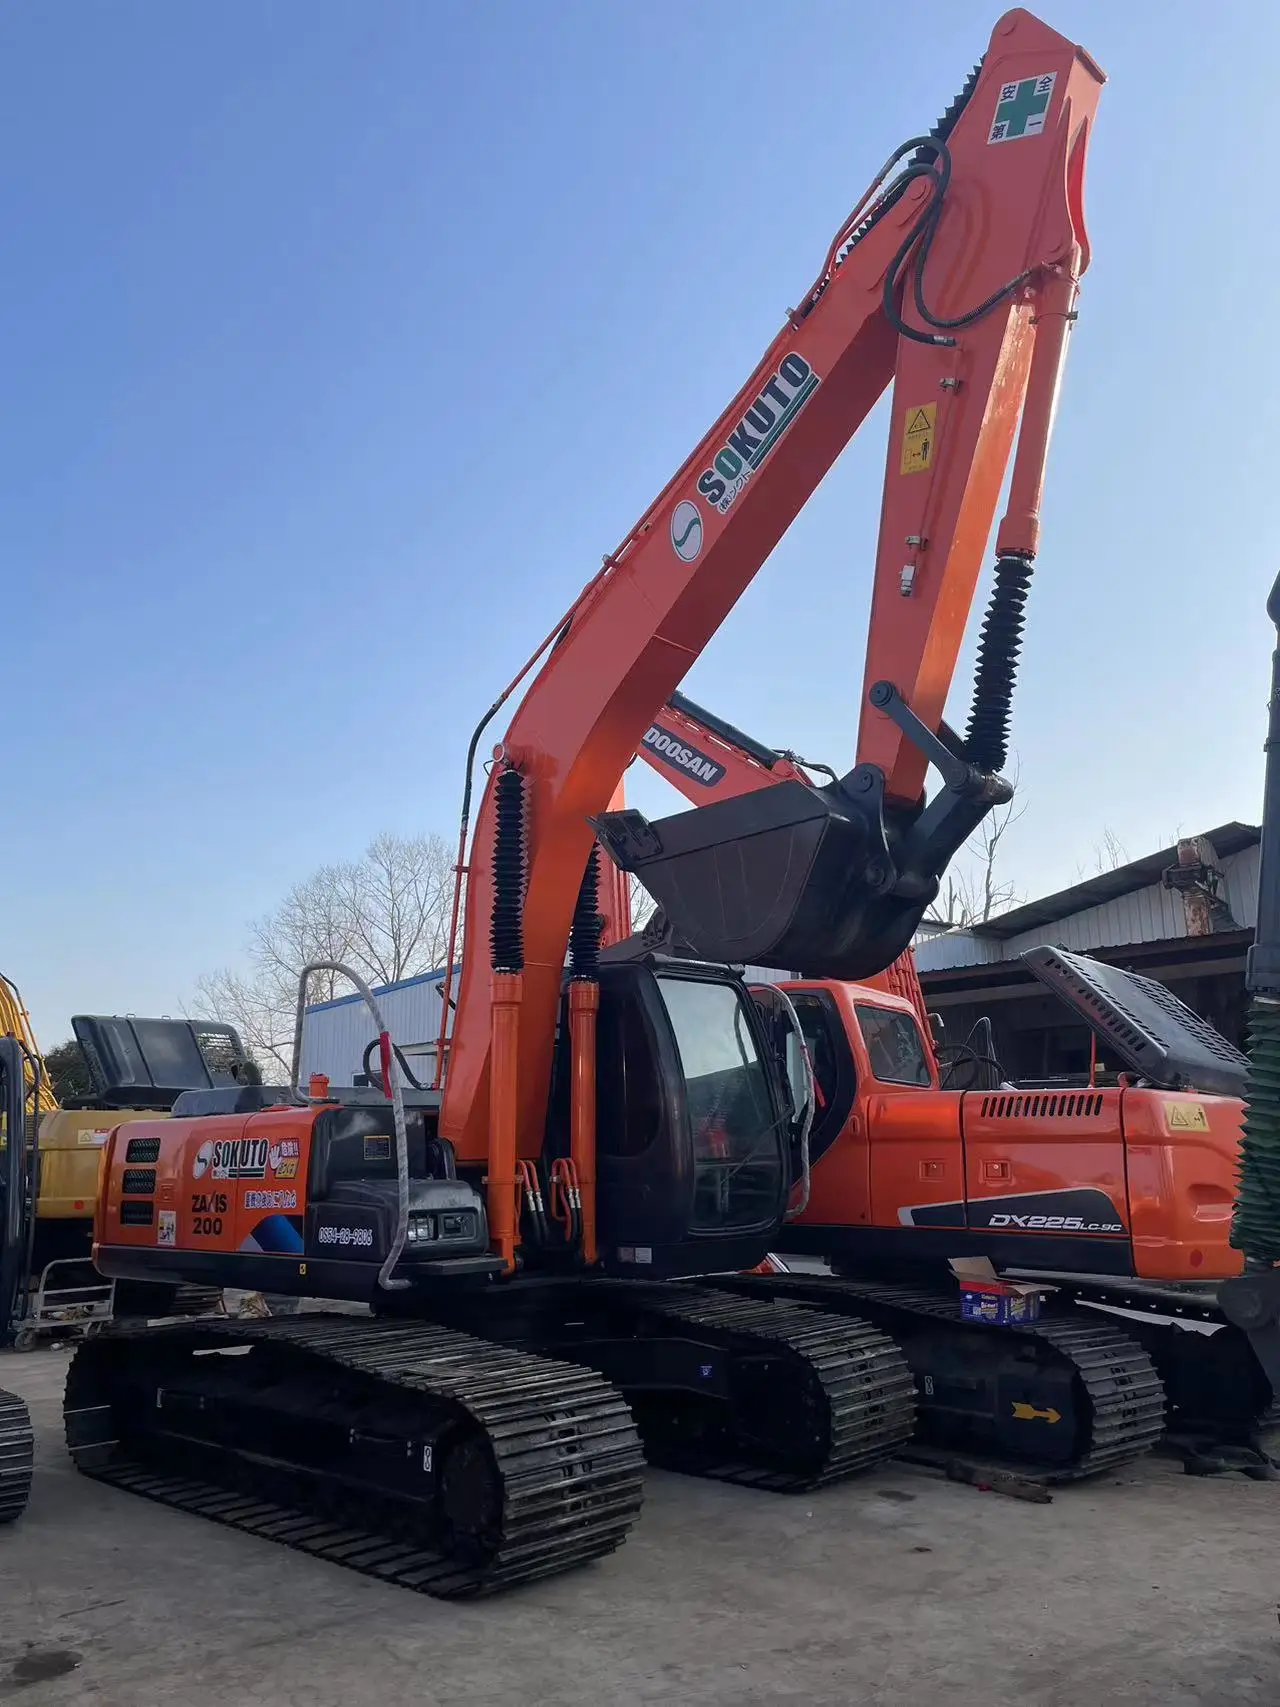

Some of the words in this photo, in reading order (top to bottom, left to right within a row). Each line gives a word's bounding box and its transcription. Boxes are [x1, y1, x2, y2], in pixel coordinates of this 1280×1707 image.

[698, 352, 812, 505] SOKUTO
[642, 726, 718, 782] DOOSAN
[213, 1138, 269, 1168] SOKUTO
[192, 1217, 223, 1236] 200
